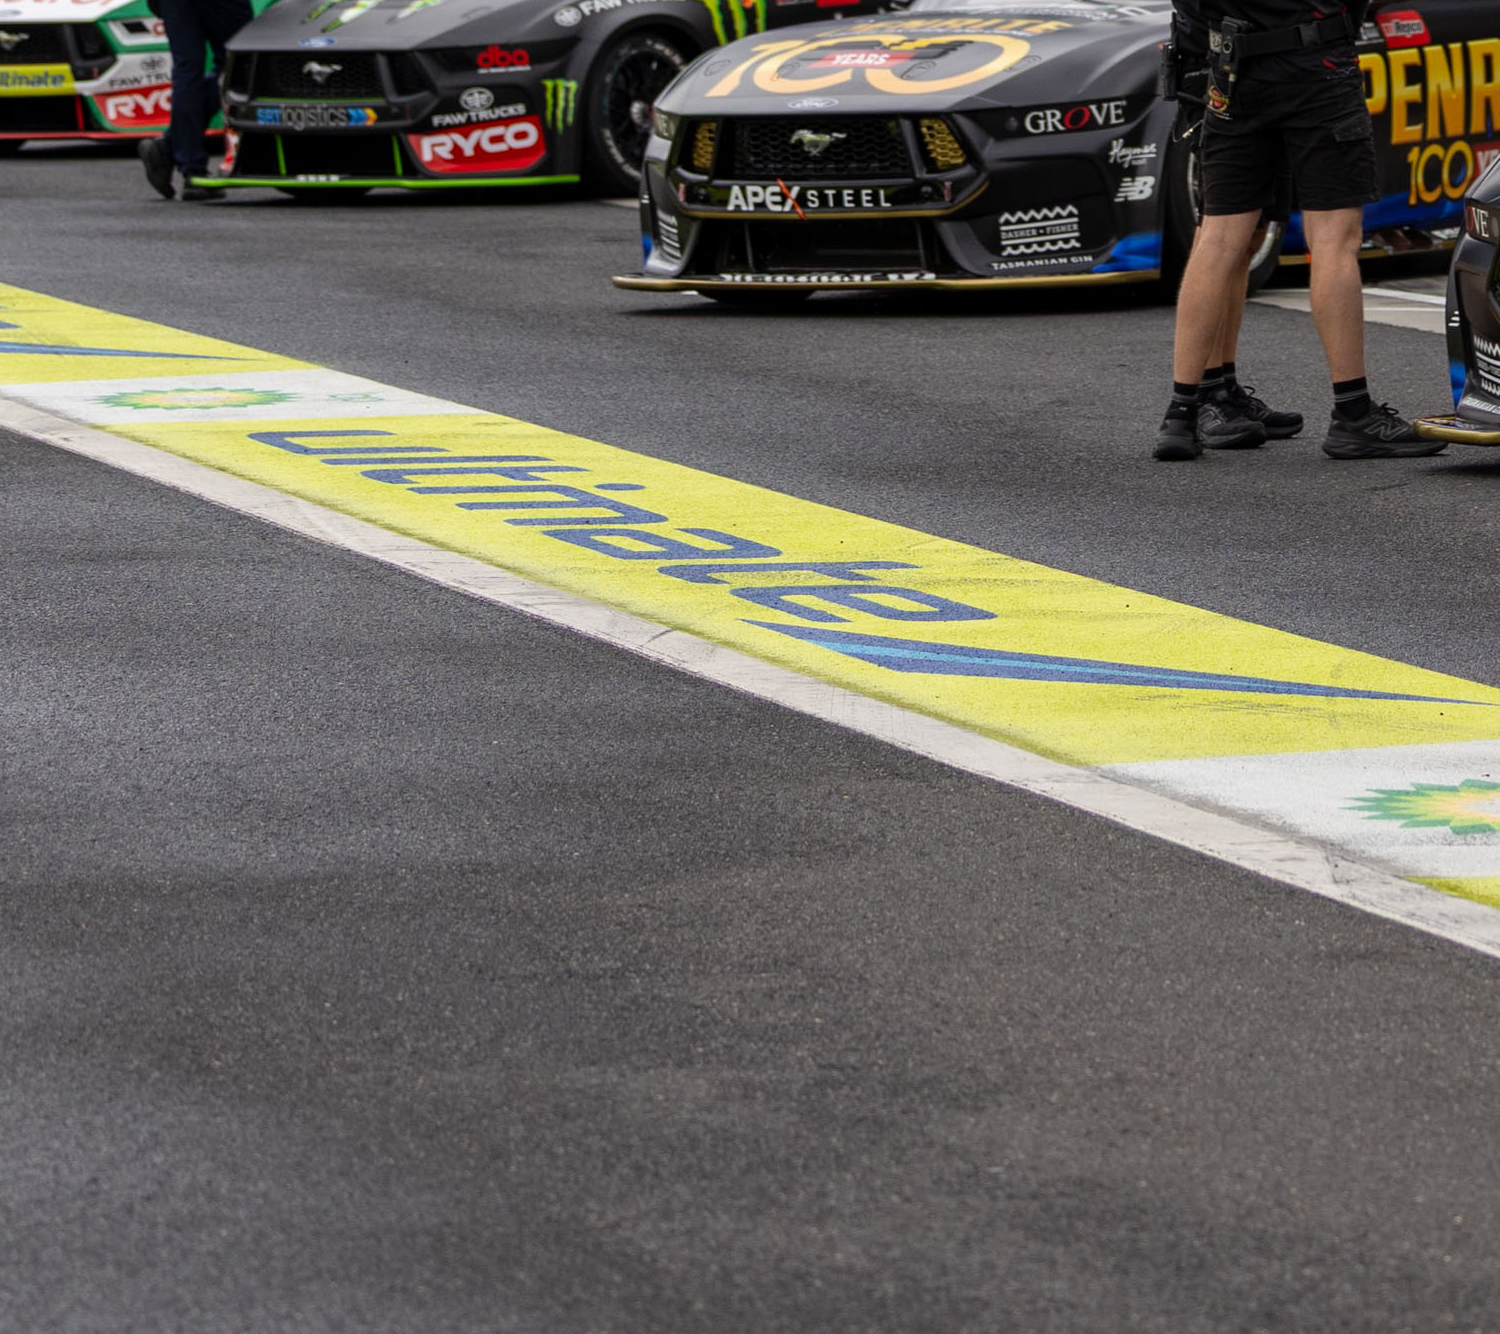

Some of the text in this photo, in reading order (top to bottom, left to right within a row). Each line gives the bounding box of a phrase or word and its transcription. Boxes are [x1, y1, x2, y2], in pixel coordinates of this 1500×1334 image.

[476, 44, 530, 70] dba
[832, 52, 891, 67] YEARS
[431, 103, 528, 129] FAW TRUCKS
[1023, 101, 1128, 134] GROVE
[419, 121, 539, 162] RYCO
[727, 184, 892, 213] APEX STEEL
[991, 254, 1094, 271] TASMANIAN GIN
[247, 428, 998, 624] ultimate
